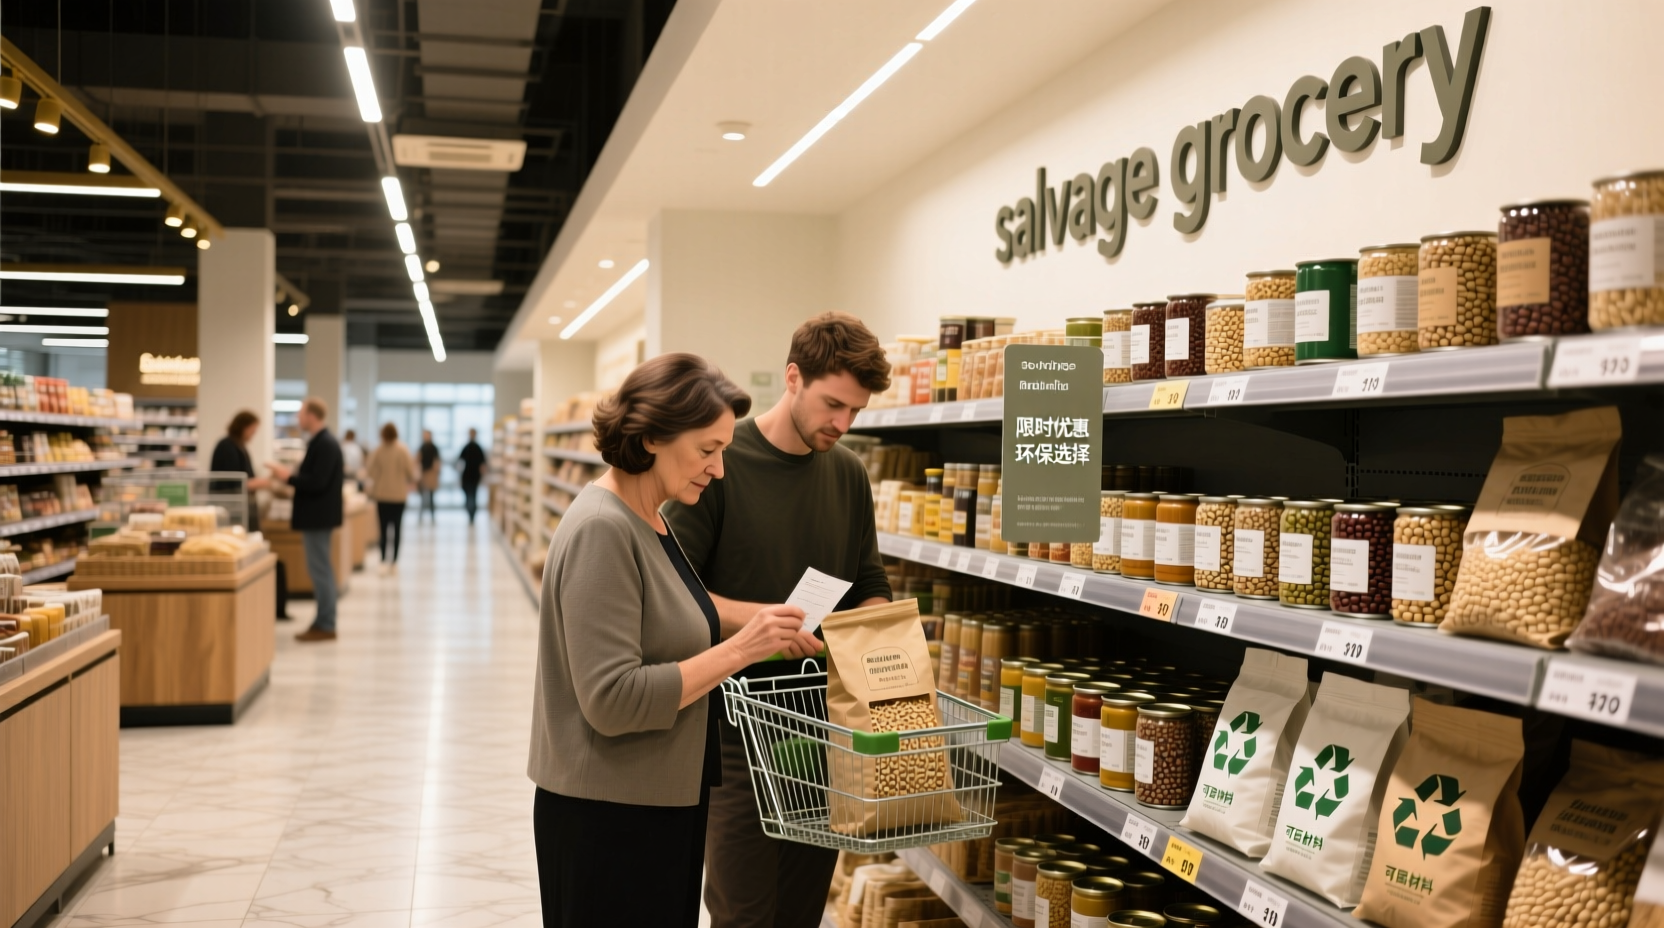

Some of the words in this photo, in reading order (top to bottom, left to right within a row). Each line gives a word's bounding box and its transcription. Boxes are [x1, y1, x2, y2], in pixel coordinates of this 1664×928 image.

[995, 147, 1160, 262] salvage
[1171, 6, 1492, 234] grocery
[1016, 416, 1089, 438] 限时优惠
[1015, 443, 1090, 466] 环保选择
